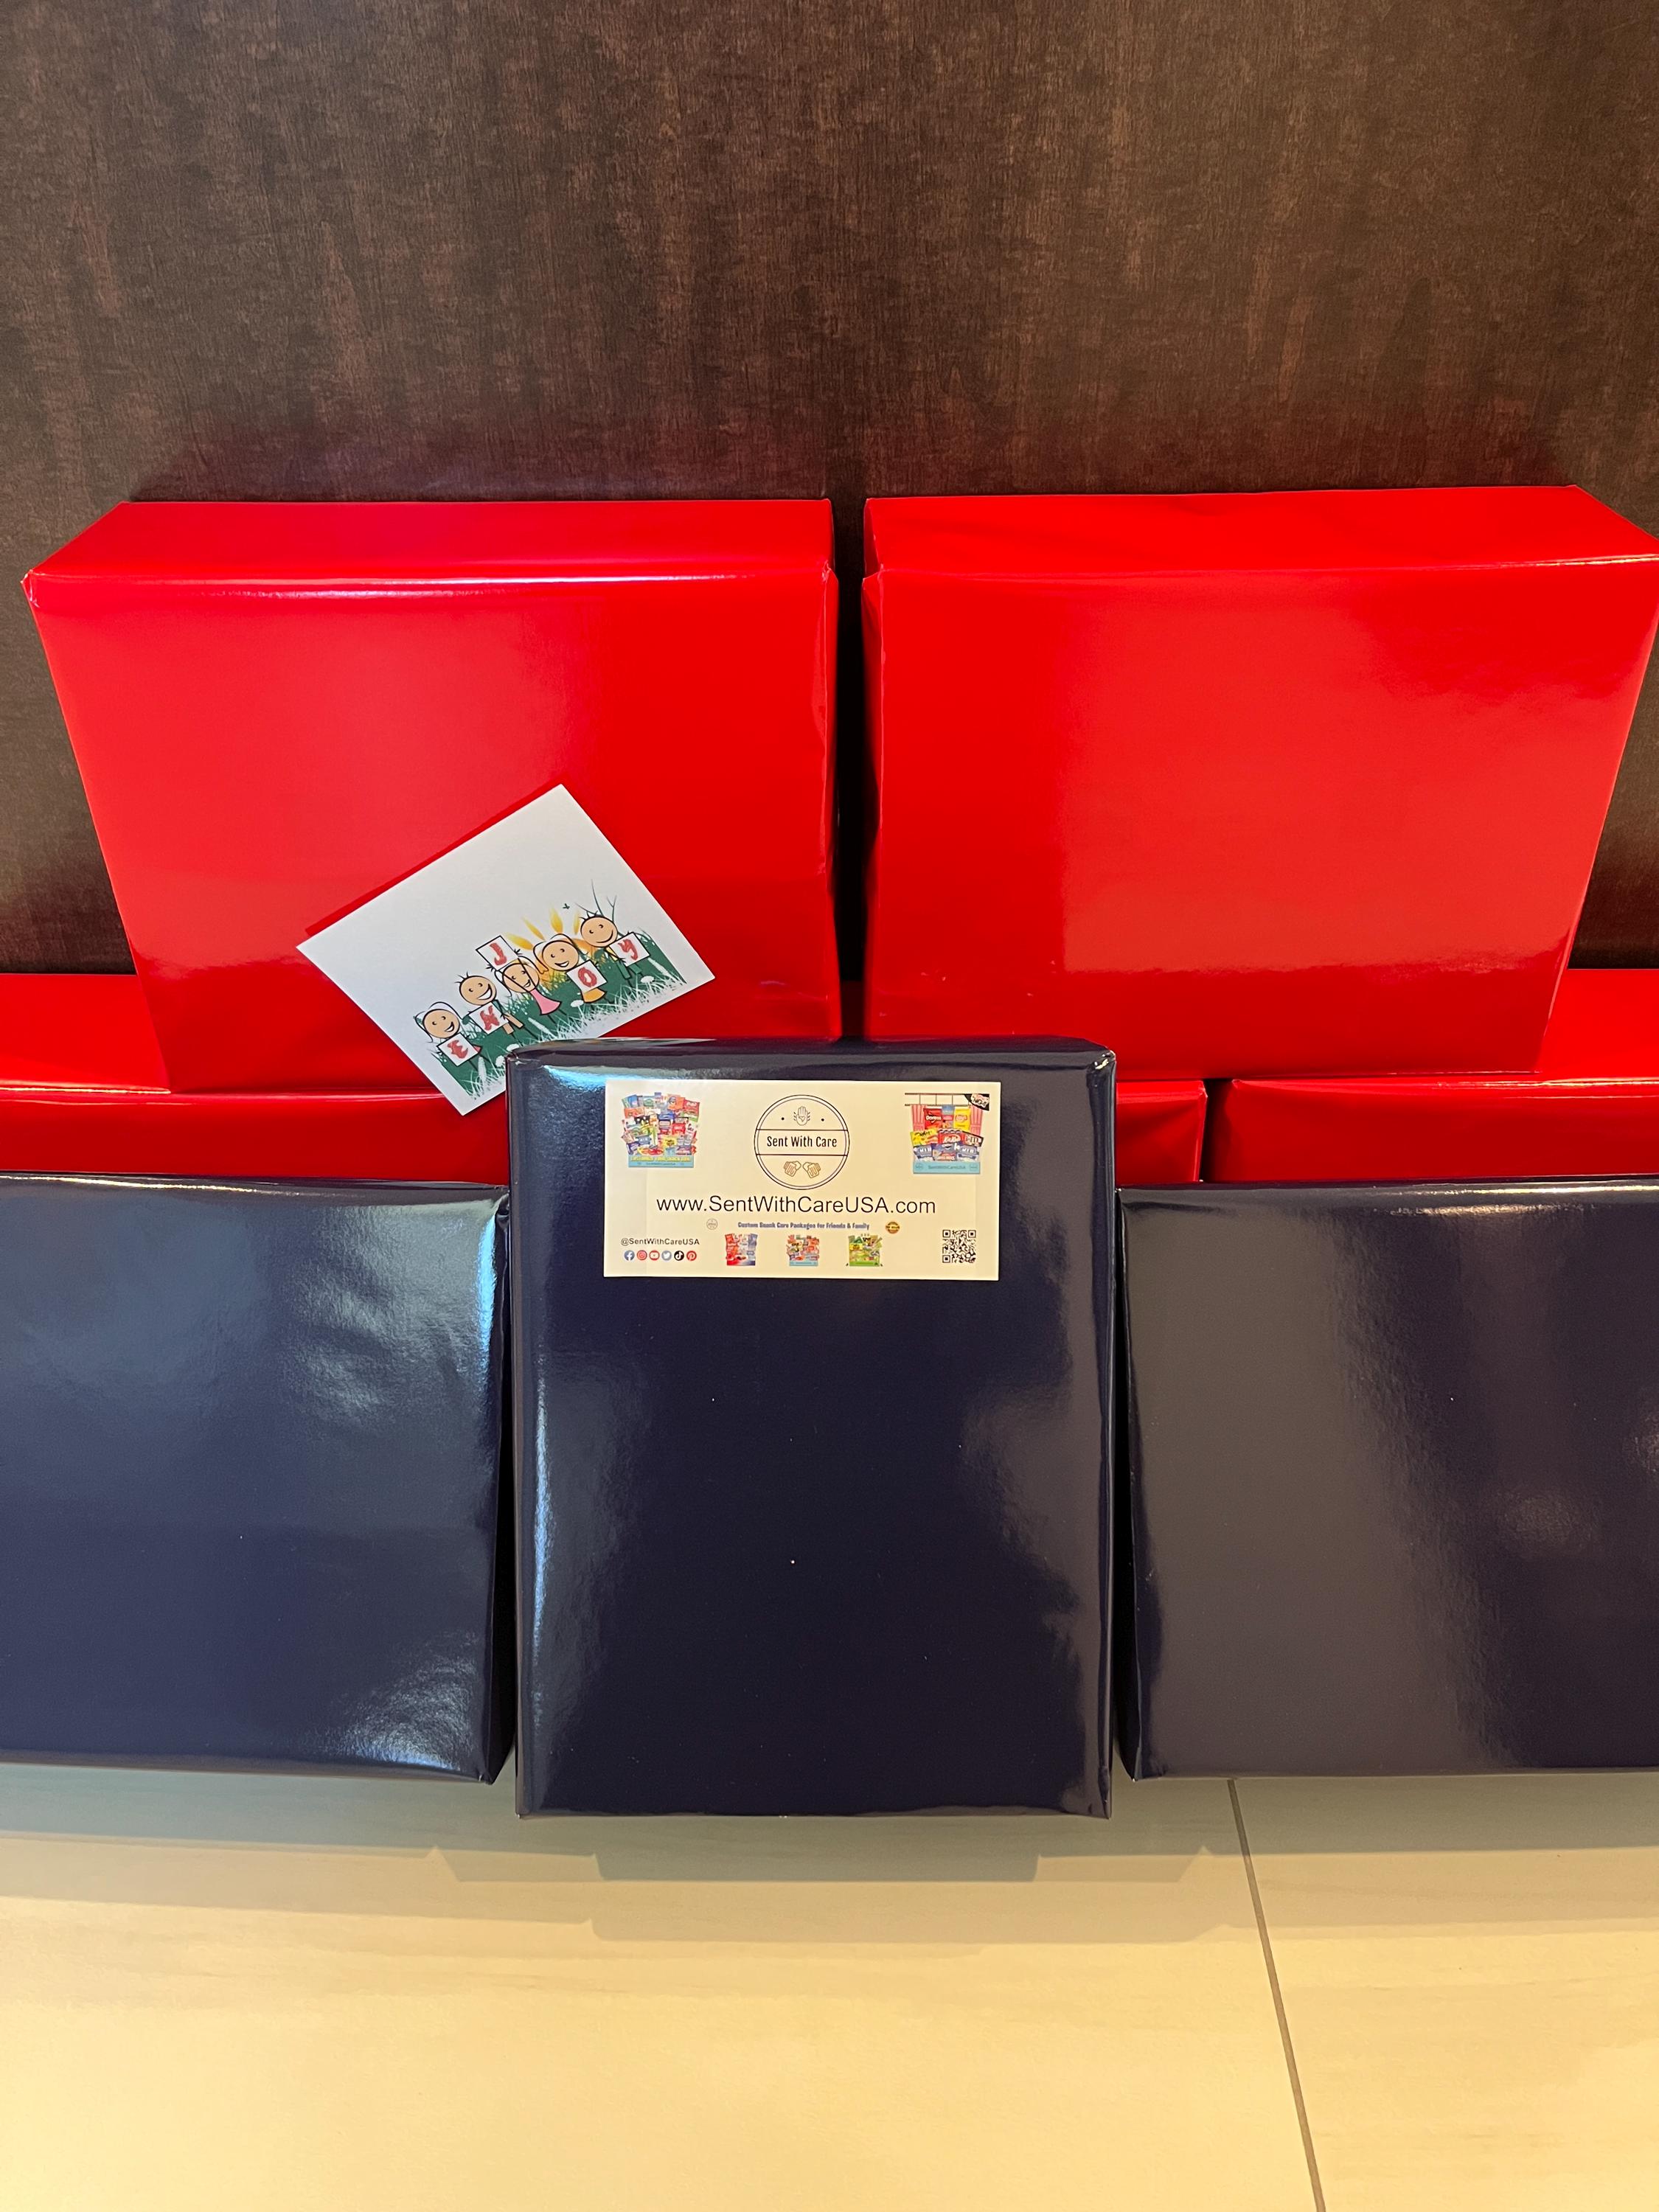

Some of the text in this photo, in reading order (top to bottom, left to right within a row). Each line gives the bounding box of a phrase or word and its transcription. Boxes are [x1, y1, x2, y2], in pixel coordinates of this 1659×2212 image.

[767, 1135, 838, 1147] Sent With Care
[656, 1195, 936, 1214] www.SentWithCareUSA.com
[790, 1222, 815, 1230] Packages
[621, 1238, 700, 1246] @SentWithCareUSA
